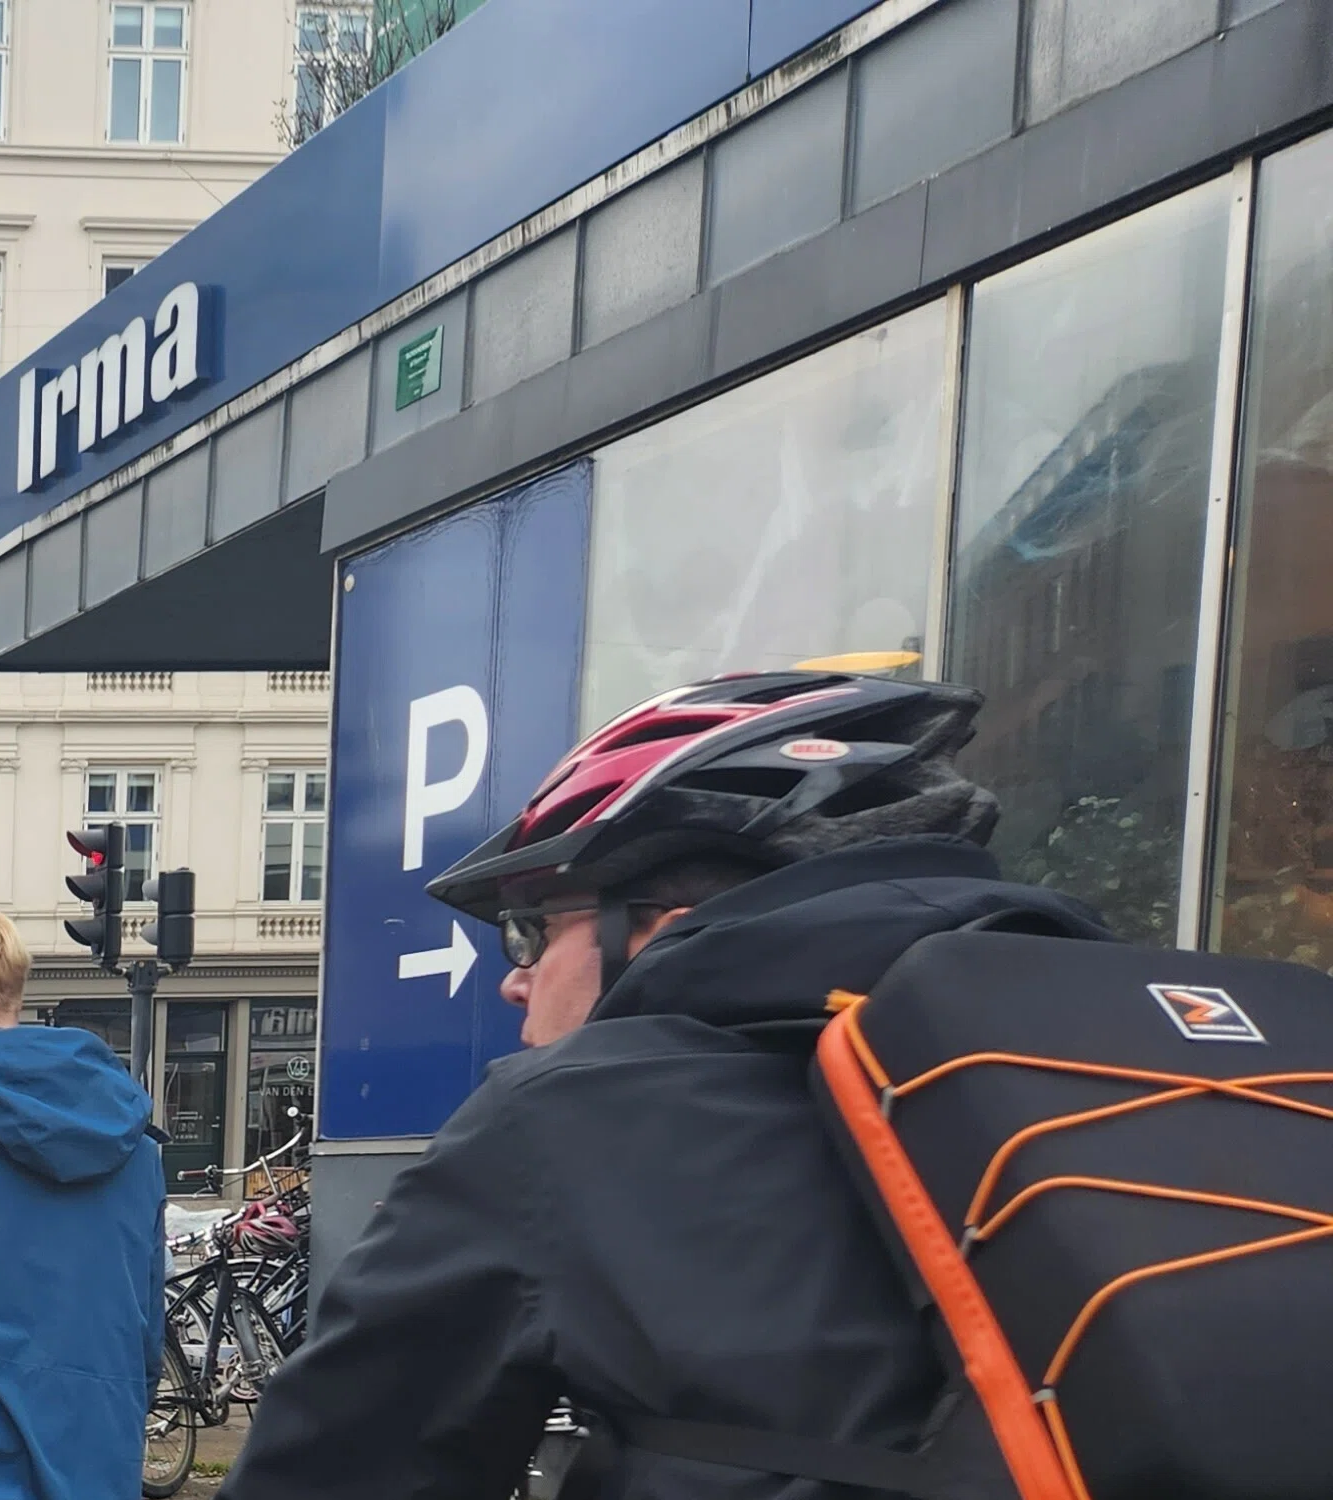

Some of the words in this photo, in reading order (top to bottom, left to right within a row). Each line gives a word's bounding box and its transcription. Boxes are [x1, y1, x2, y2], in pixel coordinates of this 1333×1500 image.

[17, 281, 200, 493] Irma
[402, 684, 488, 872] P
[789, 743, 839, 756] BELL
[259, 1087, 279, 1096] VAN
[283, 1086, 304, 1096] DEN
